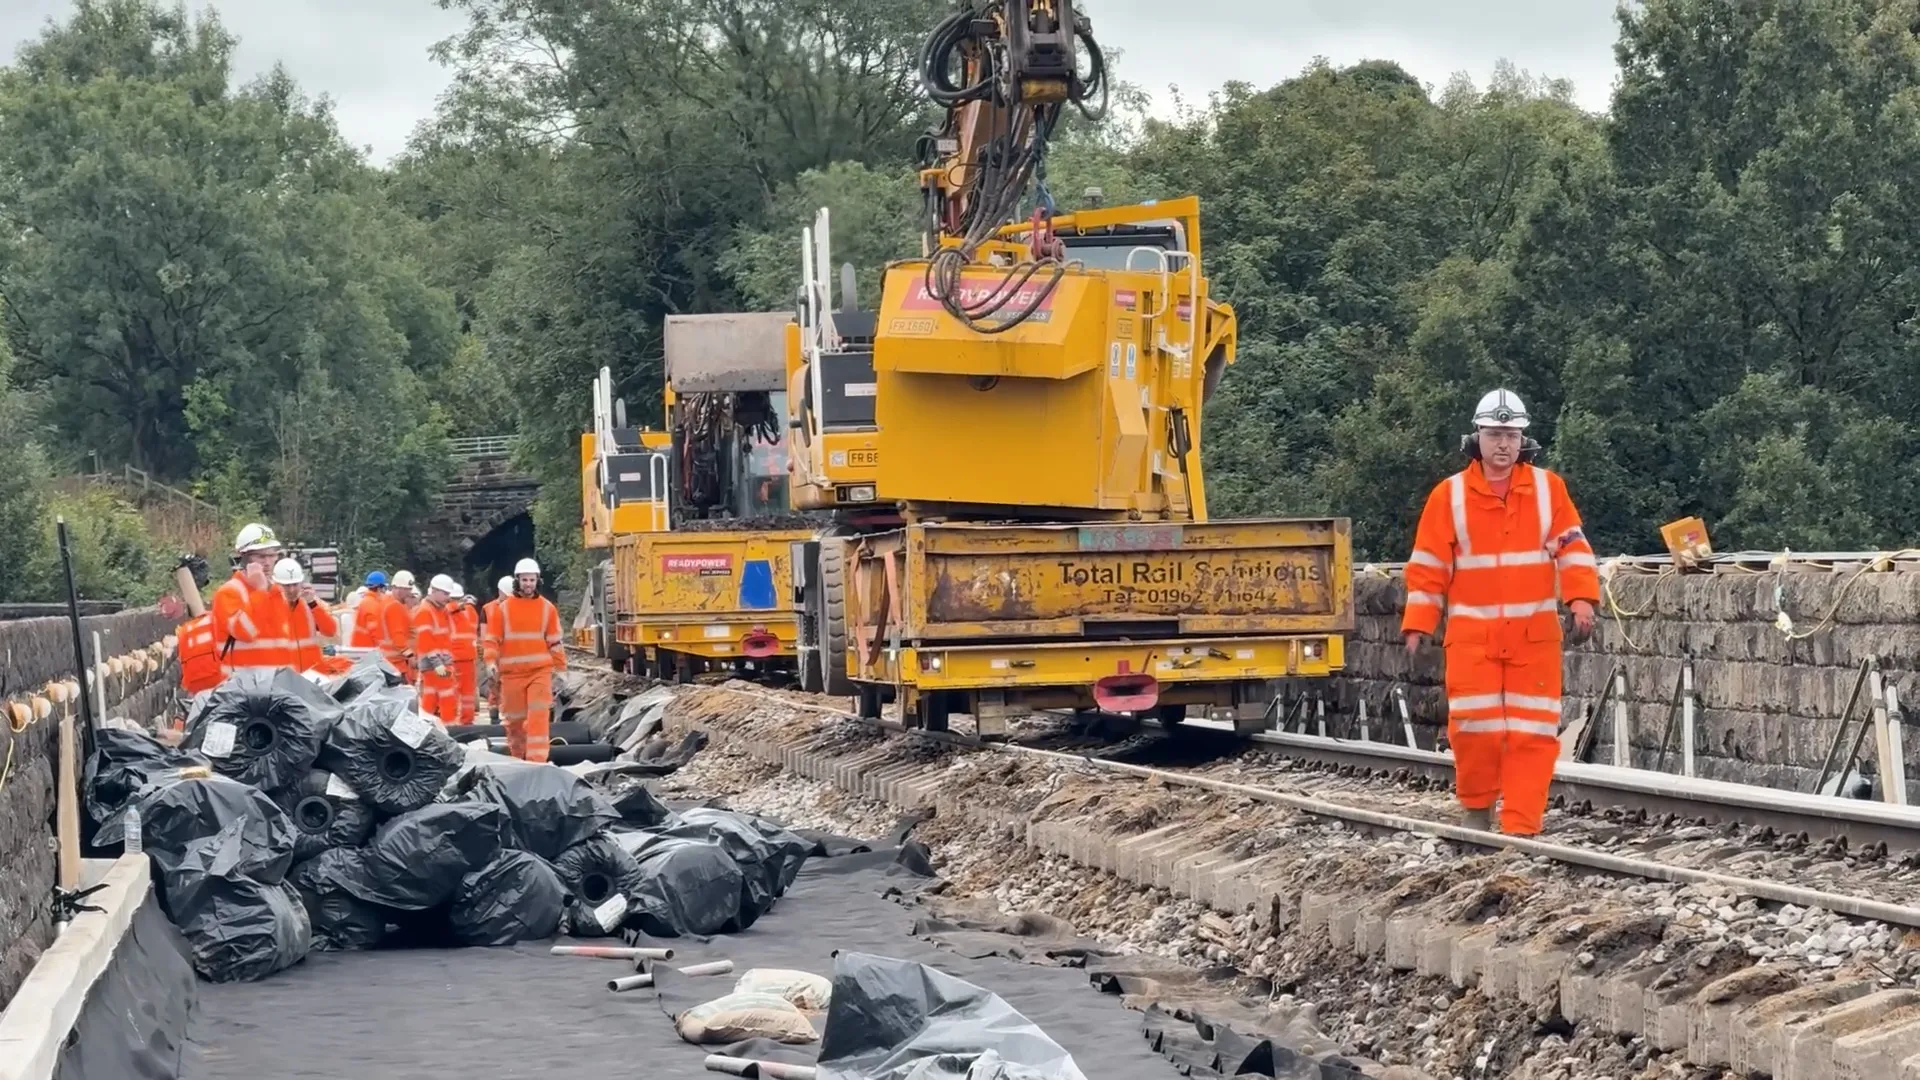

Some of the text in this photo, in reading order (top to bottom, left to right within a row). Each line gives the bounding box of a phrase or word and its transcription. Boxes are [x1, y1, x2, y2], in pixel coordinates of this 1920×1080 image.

[851, 453, 864, 463] FR
[667, 559, 727, 568] READYPOWER
[1058, 562, 1121, 586] Total
[1133, 561, 1182, 583] Rail
